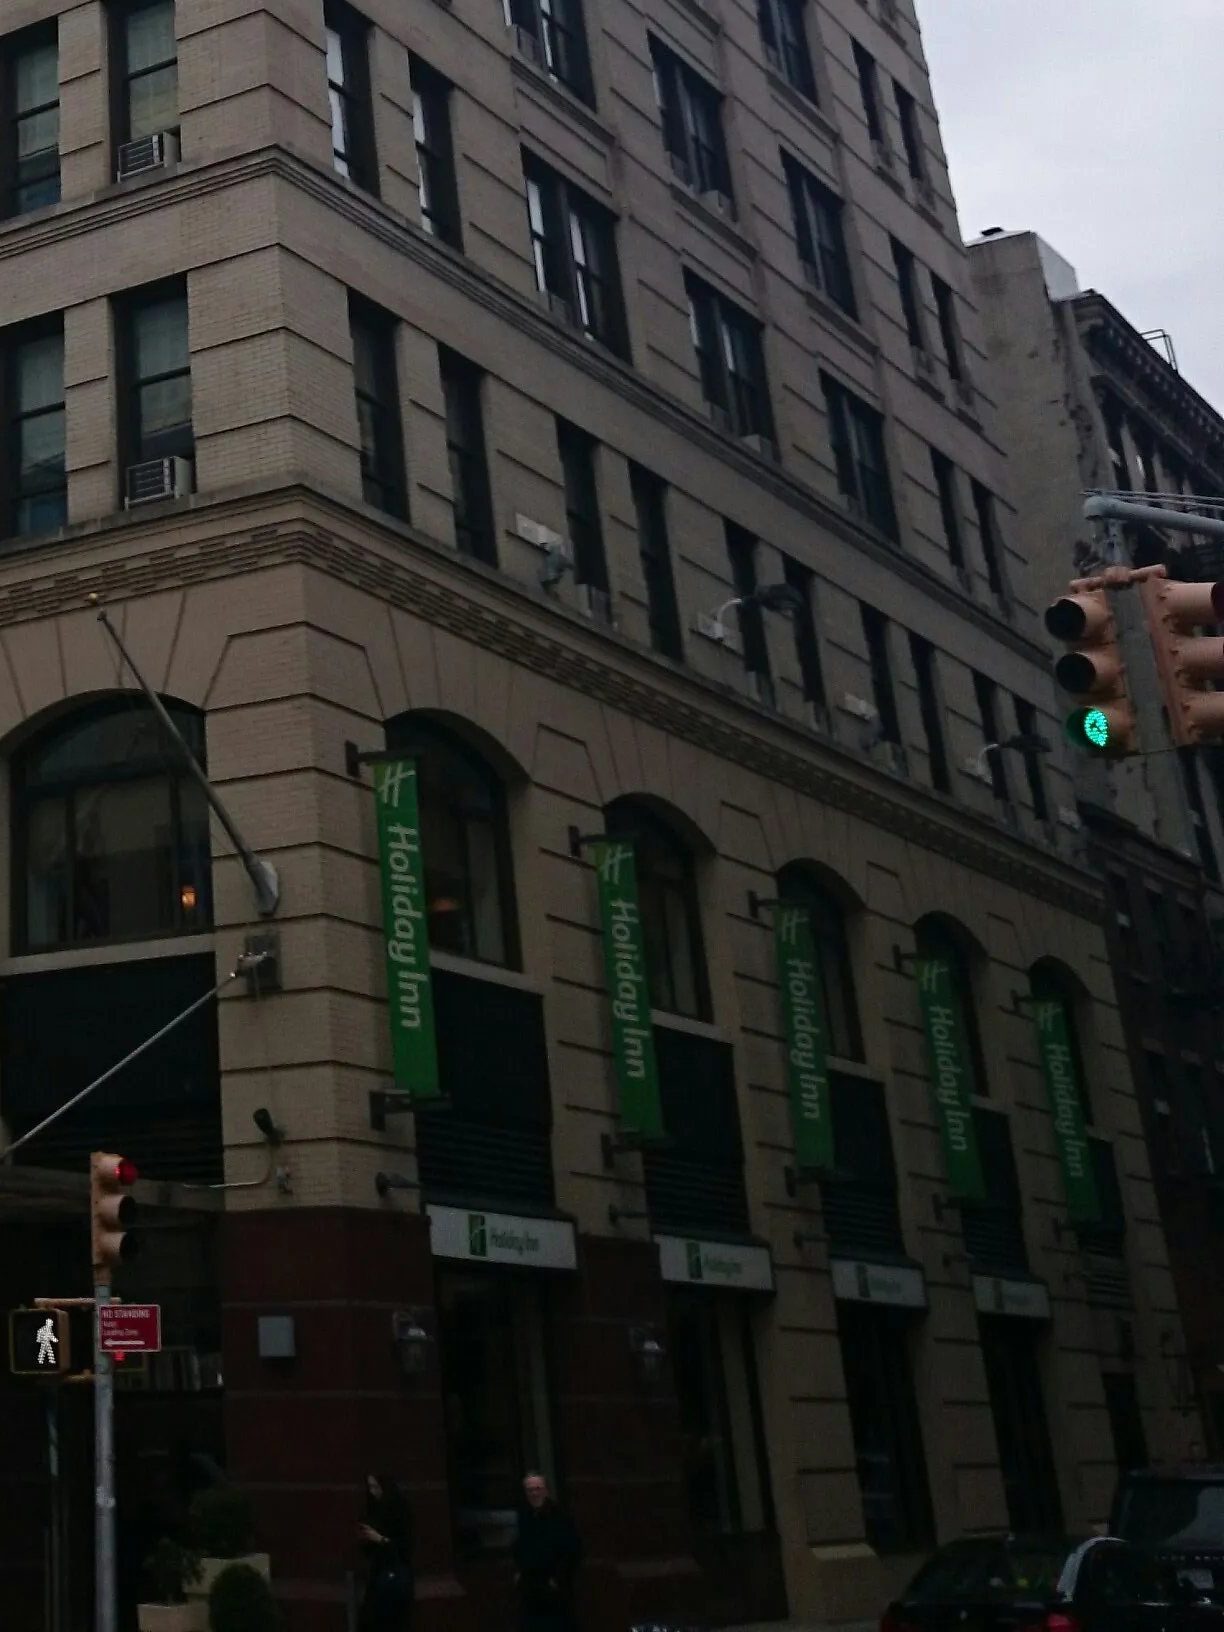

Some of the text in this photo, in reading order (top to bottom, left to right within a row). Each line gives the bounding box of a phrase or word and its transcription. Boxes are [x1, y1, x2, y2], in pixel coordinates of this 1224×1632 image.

[387, 822, 428, 1029] Holiday Inn
[610, 898, 651, 1079] Holiday Inn
[787, 958, 826, 1119] Holiday Inn
[929, 1005, 971, 1152] Holiday Inn
[1045, 1044, 1087, 1178] Holiday Inn
